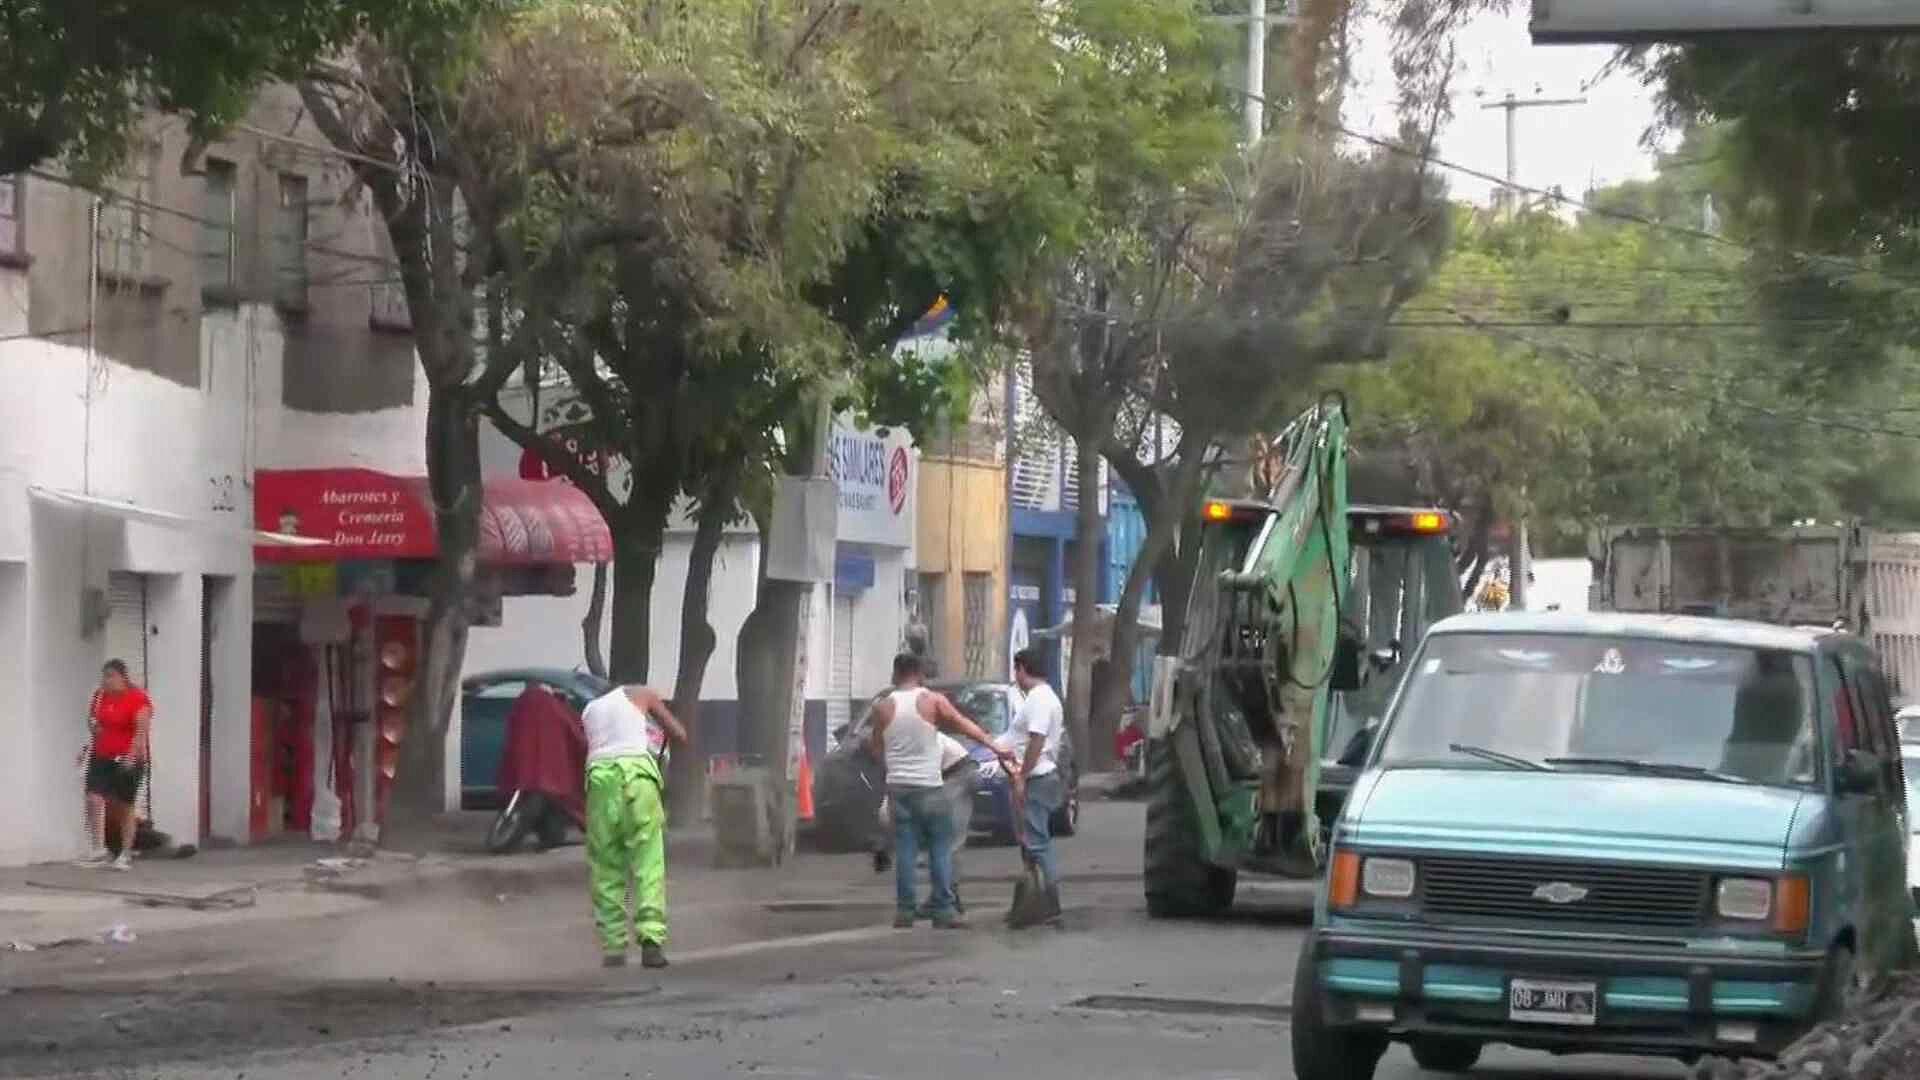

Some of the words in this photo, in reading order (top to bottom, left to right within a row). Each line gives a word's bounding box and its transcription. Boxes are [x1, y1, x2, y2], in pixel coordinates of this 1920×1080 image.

[841, 436, 884, 487] SIMILARES
[320, 489, 388, 504] Abarrotes
[390, 491, 400, 505] y
[335, 530, 364, 546] Don
[367, 530, 405, 546] Jerry
